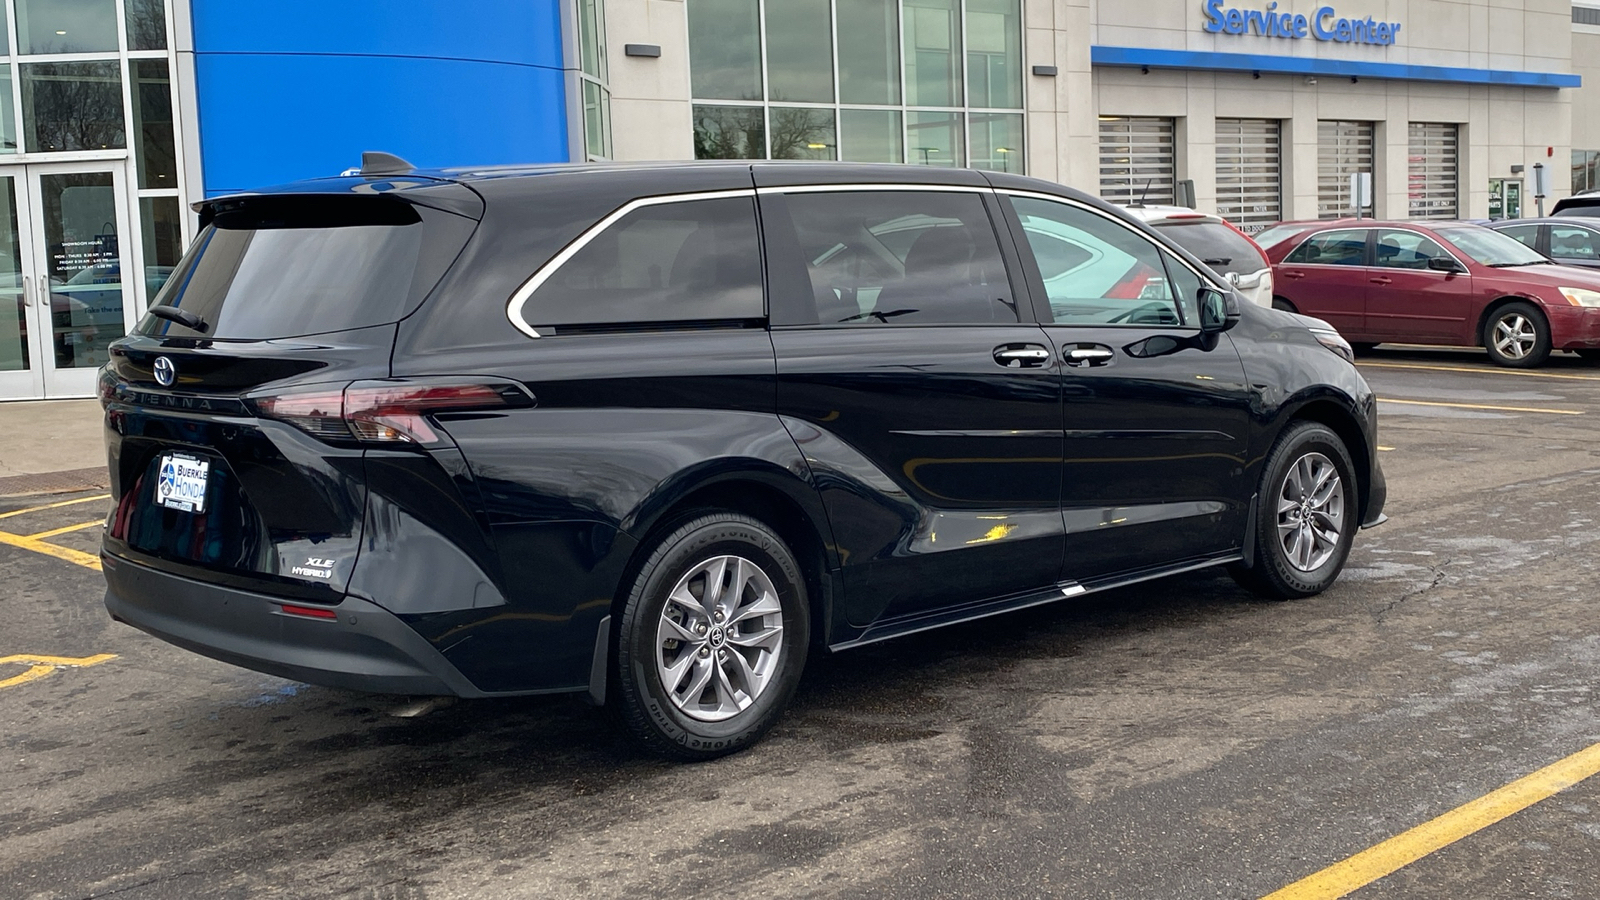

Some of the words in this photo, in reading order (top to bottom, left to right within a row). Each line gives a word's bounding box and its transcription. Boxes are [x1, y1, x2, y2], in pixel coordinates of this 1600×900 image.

[1203, 0, 1308, 39] Service
[1311, 6, 1402, 45] Center
[123, 391, 212, 410] SIENNA
[177, 464, 209, 480] BUERKLE
[175, 477, 206, 498] HONDA
[305, 557, 336, 568] XLE
[292, 566, 324, 578] HYBRID
